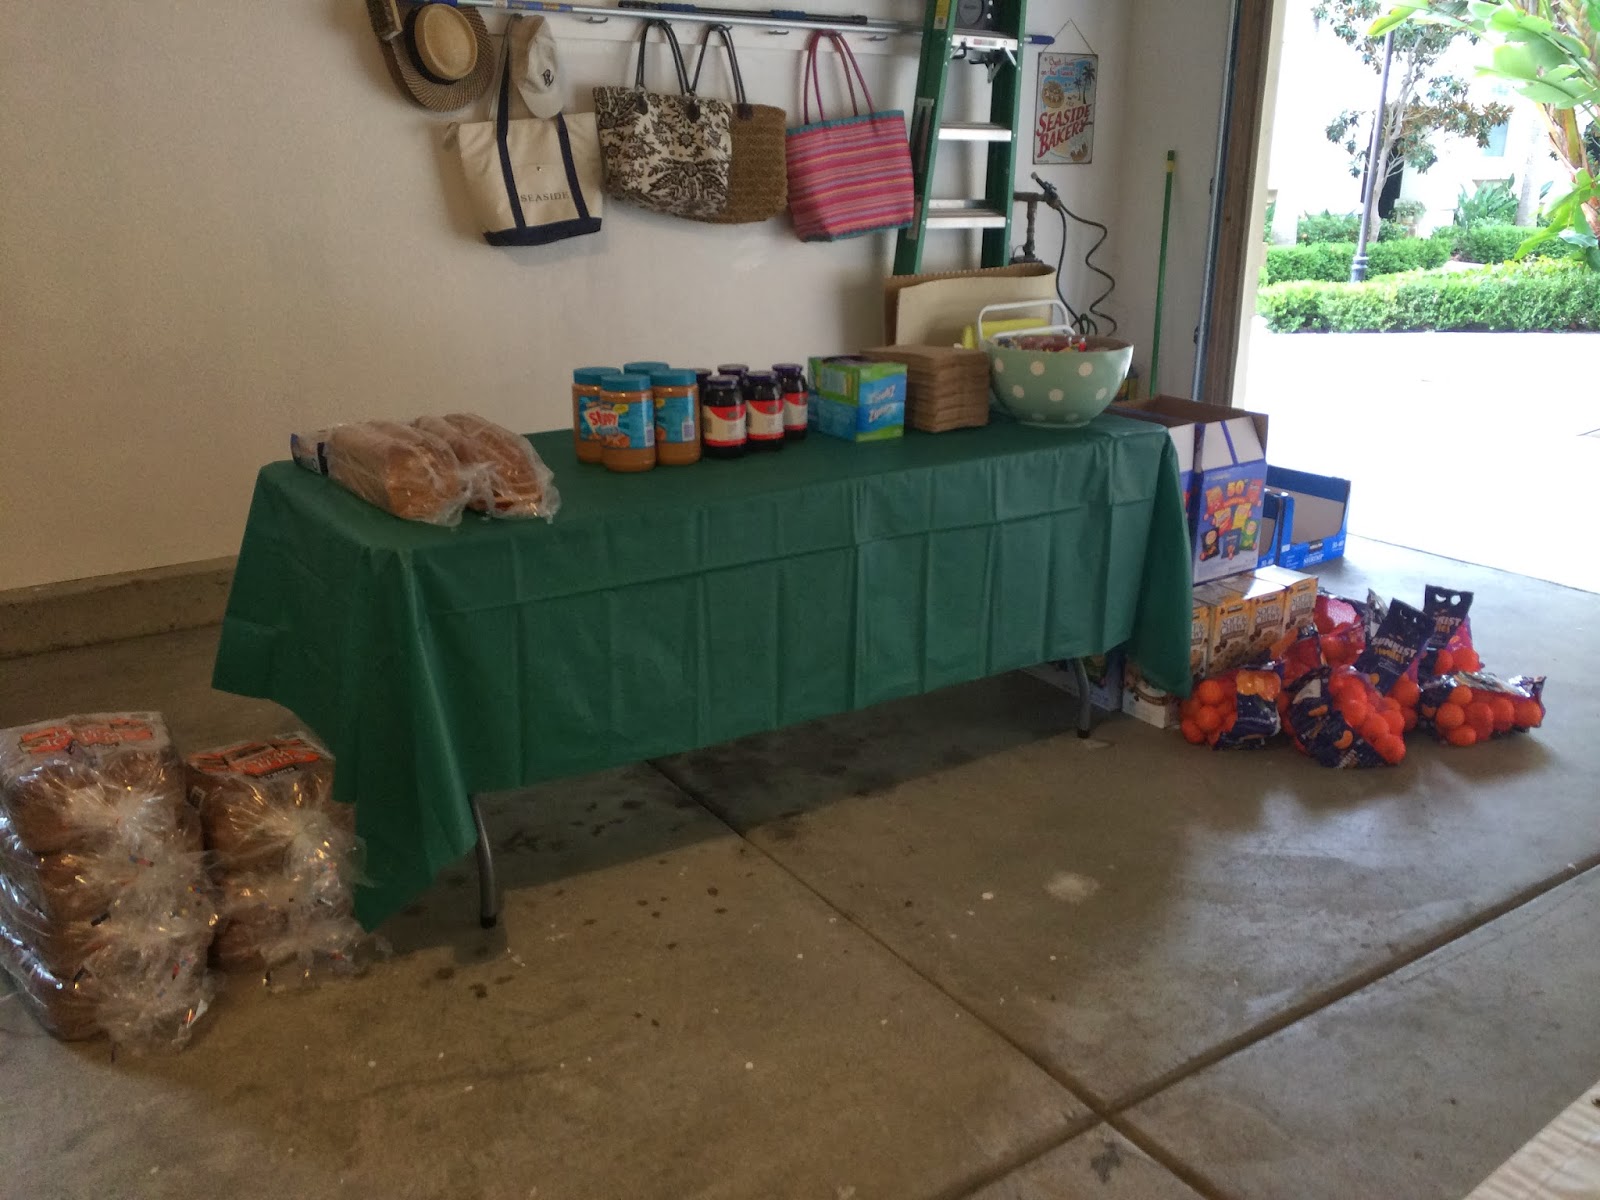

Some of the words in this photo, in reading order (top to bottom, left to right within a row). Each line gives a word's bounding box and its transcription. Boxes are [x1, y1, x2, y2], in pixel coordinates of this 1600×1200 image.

[1039, 104, 1092, 133] SEASIDE
[1036, 120, 1093, 158] BAKERY
[520, 191, 570, 203] SEASIDE
[1371, 637, 1417, 658] SUNKIST
